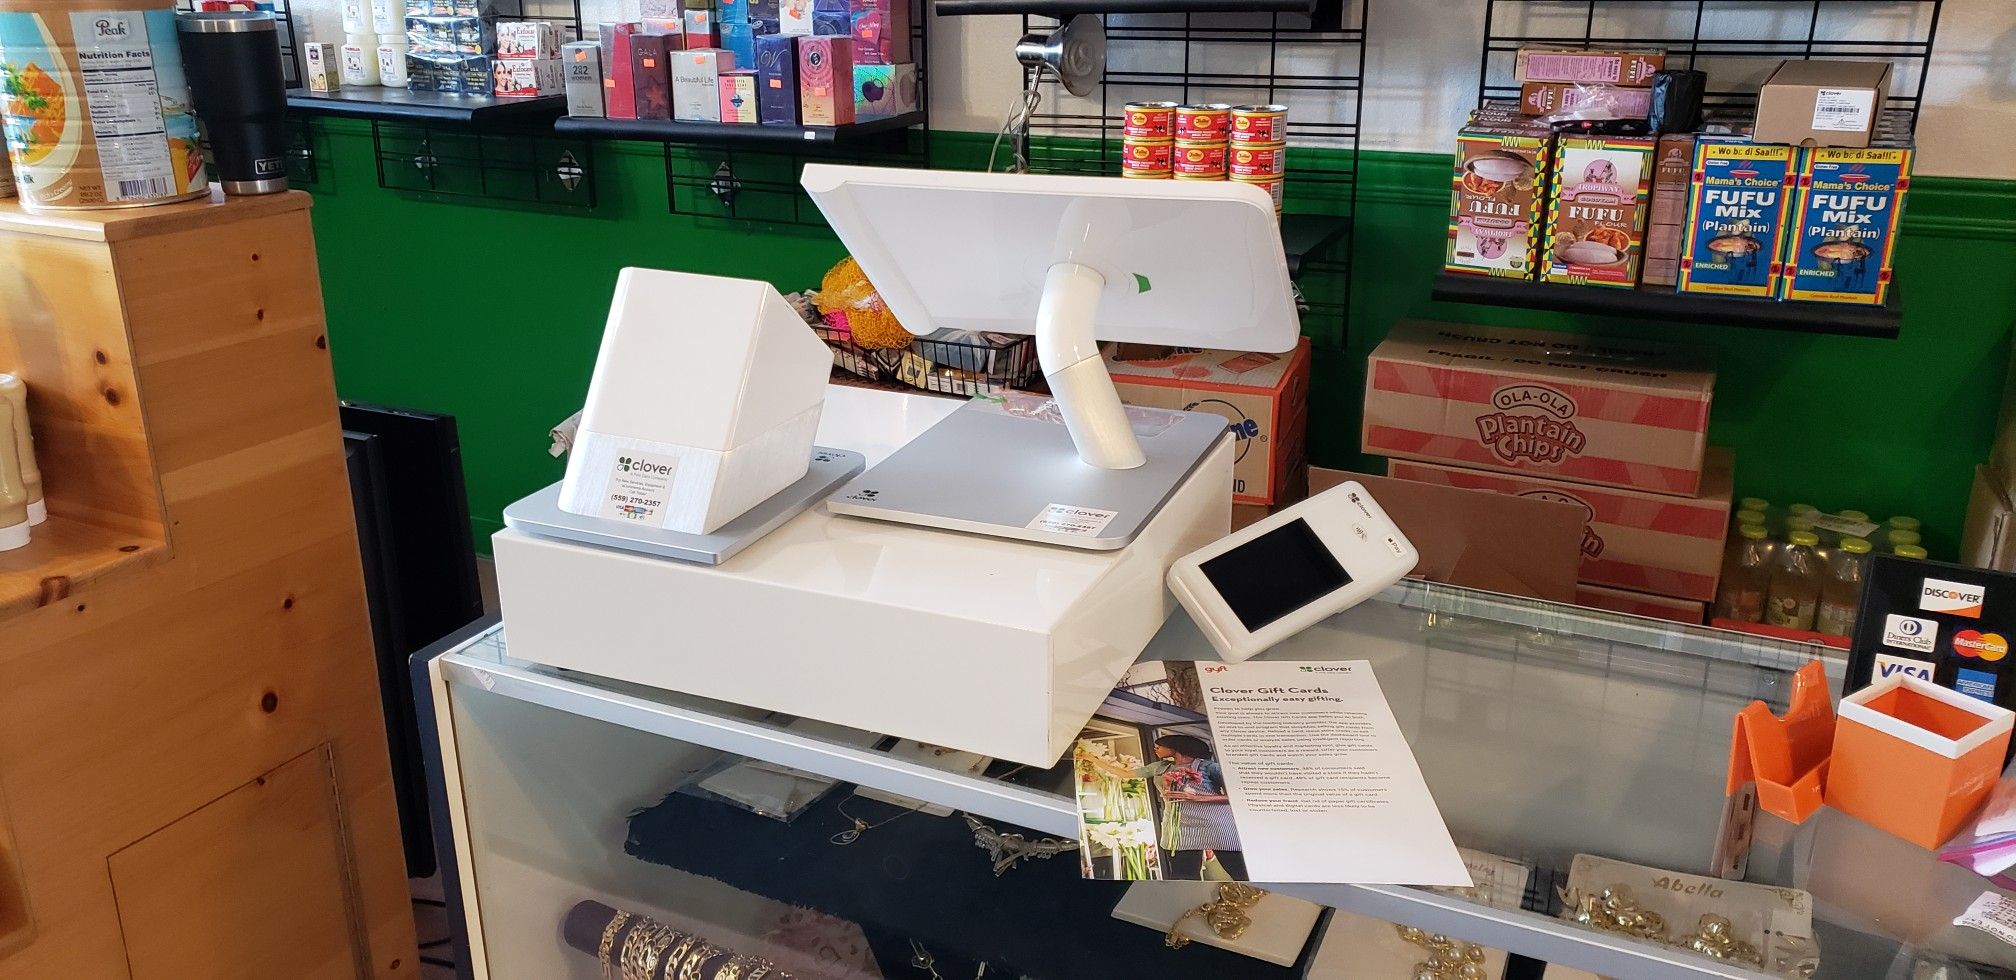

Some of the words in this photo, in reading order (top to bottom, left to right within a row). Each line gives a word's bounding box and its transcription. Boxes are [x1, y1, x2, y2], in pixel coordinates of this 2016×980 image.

[95, 20, 127, 36] Peak
[79, 51, 124, 60] Nutrition
[126, 50, 151, 58] Facts
[1628, 60, 1636, 80] FUFU
[258, 161, 283, 171] YETI
[1578, 183, 1619, 193] TROPIWAY
[1706, 177, 1742, 186] Mama's
[1744, 178, 1778, 187] Choice
[1813, 181, 1851, 190] Mama's
[1854, 182, 1890, 191] Choice
[1705, 190, 1776, 206] FUFU
[1812, 195, 1887, 211] FUFU
[1469, 200, 1521, 216] FUFU
[1568, 205, 1624, 221] FUFU
[1715, 206, 1762, 219] Mix
[1594, 220, 1628, 228] FLOUR
[1822, 211, 1873, 224] Mix
[1702, 220, 1770, 234] (Plantain)
[1808, 226, 1880, 239] (Plantain)
[1695, 262, 1729, 270] ENRICHED
[1799, 269, 1835, 277] ENRICHED
[1547, 361, 1587, 370] NOT
[1595, 366, 1668, 378] CRUSH
[1501, 391, 1568, 415] OLA-OLA
[1479, 415, 1583, 450] Plantain
[1497, 434, 1562, 459] Chips
[632, 459, 672, 476] clover
[611, 494, 629, 503] (559)
[1066, 510, 1111, 519] clover
[1357, 502, 1372, 518] clover
[1392, 542, 1402, 553] Pay
[1924, 587, 1981, 603] DISCOVER
[1887, 631, 1911, 642] Diners
[1913, 636, 1932, 645] Club
[1205, 665, 1228, 673] gyft
[1880, 663, 1930, 682] VISA
[1957, 679, 1994, 690] AMERICAN
[1653, 876, 1725, 898] Abella
